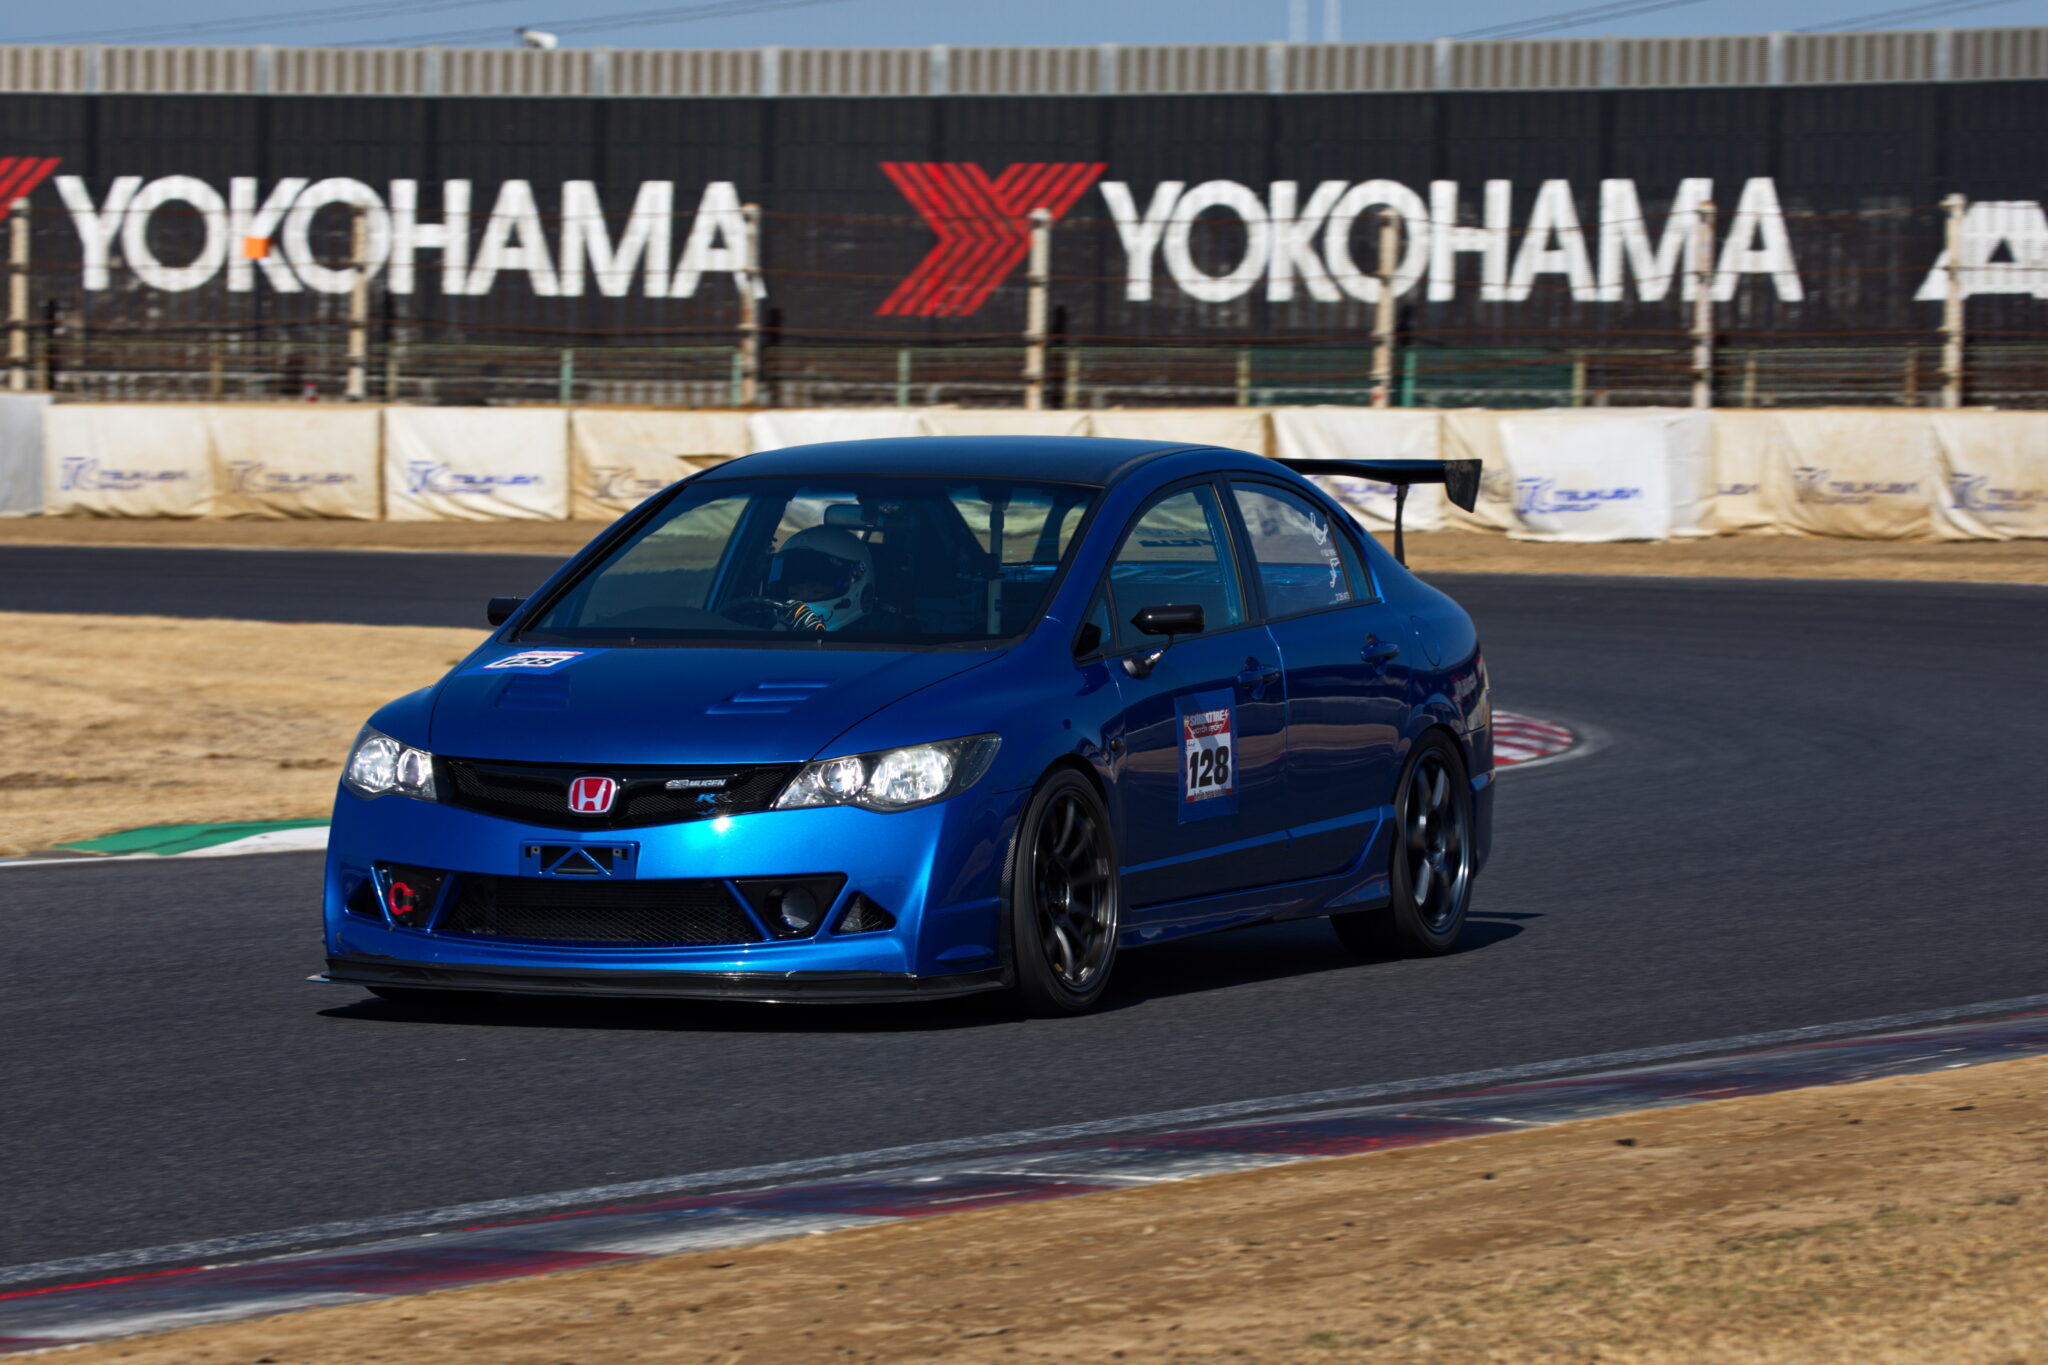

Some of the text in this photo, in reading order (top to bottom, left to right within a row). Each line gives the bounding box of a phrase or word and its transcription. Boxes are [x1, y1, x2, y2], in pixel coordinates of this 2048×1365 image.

[55, 175, 767, 299] YOKOHAMA
[1099, 177, 1804, 303] YOKOHAMA
[689, 779, 726, 787] MUGEN
[1190, 746, 1229, 788] 128
